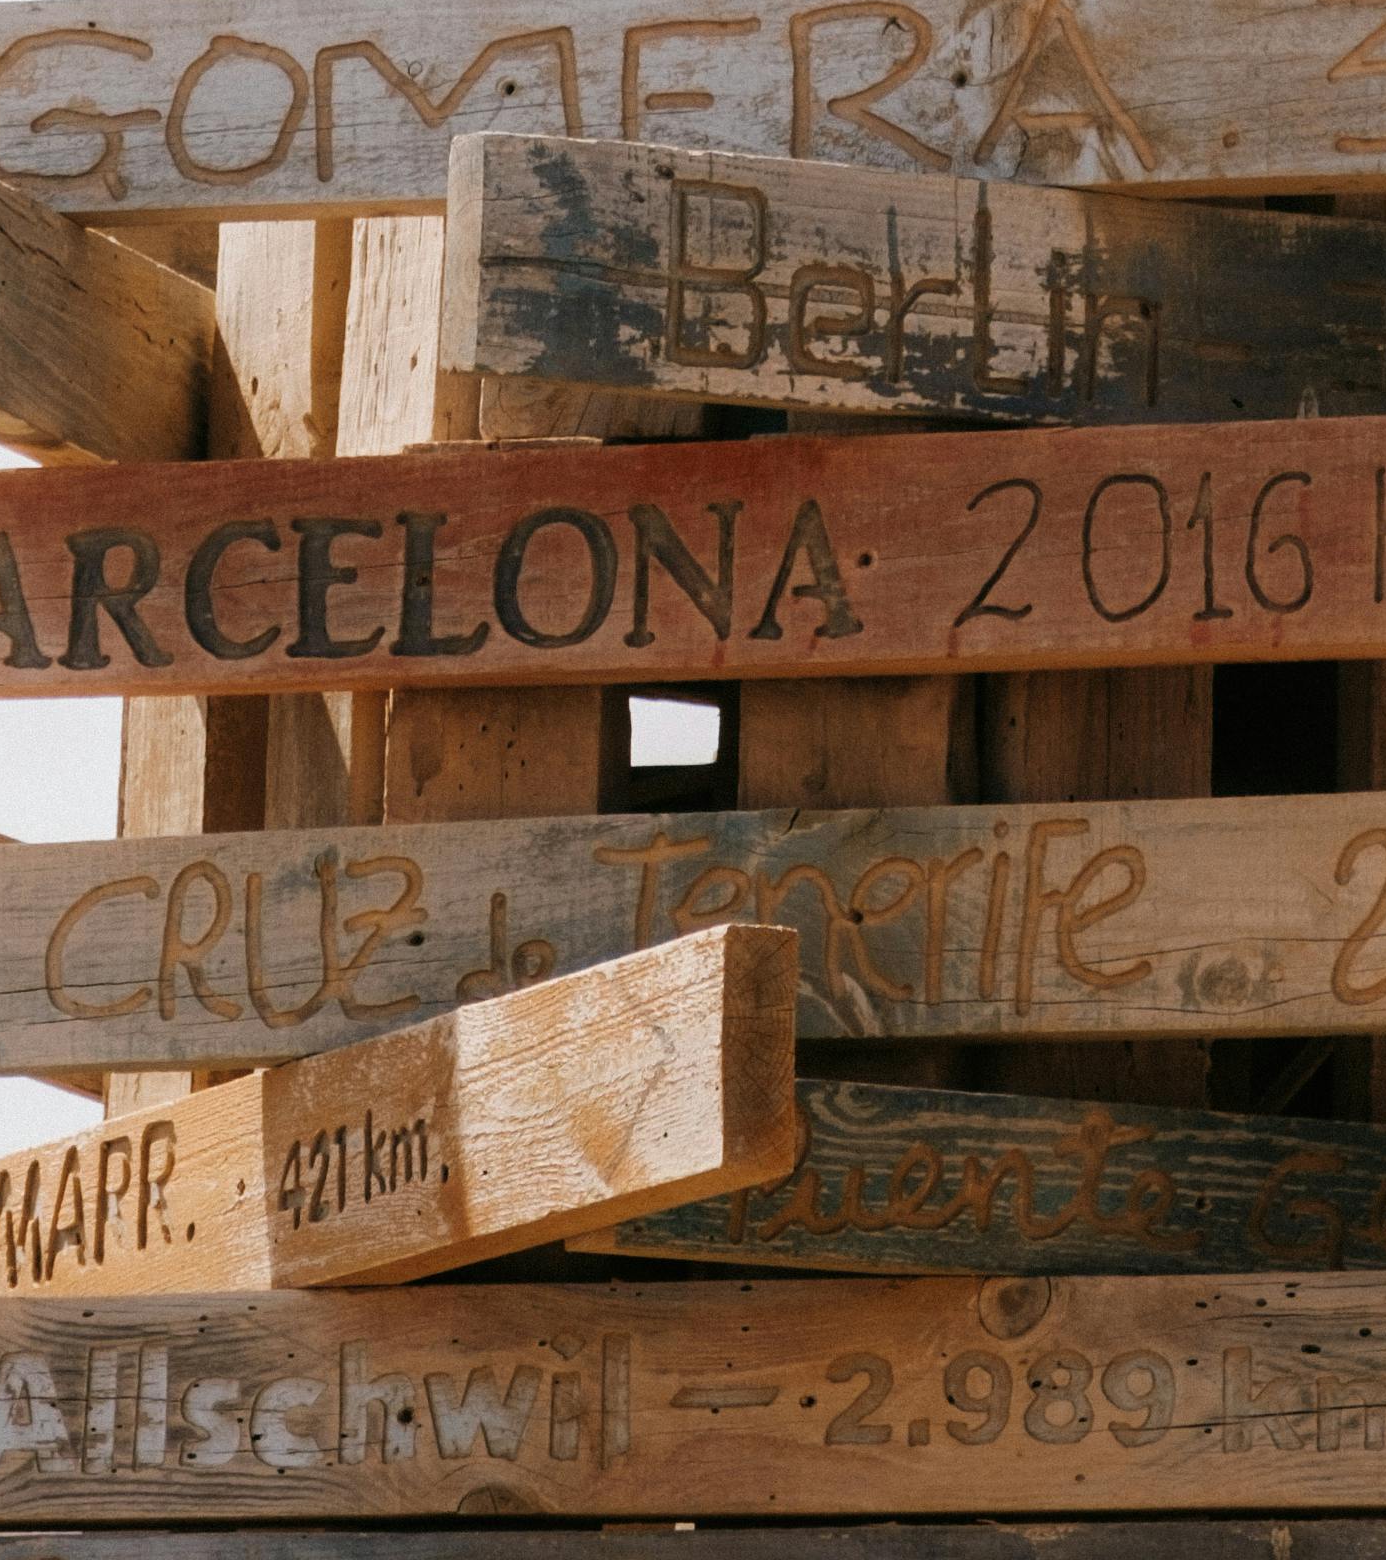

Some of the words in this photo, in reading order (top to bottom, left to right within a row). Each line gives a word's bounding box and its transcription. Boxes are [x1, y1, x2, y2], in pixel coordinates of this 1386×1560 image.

[953, 471, 1316, 628] 2016
[276, 1124, 347, 1231] 421
[726, 1108, 1205, 1256] uente
[823, 1348, 1177, 1449] 2.989
